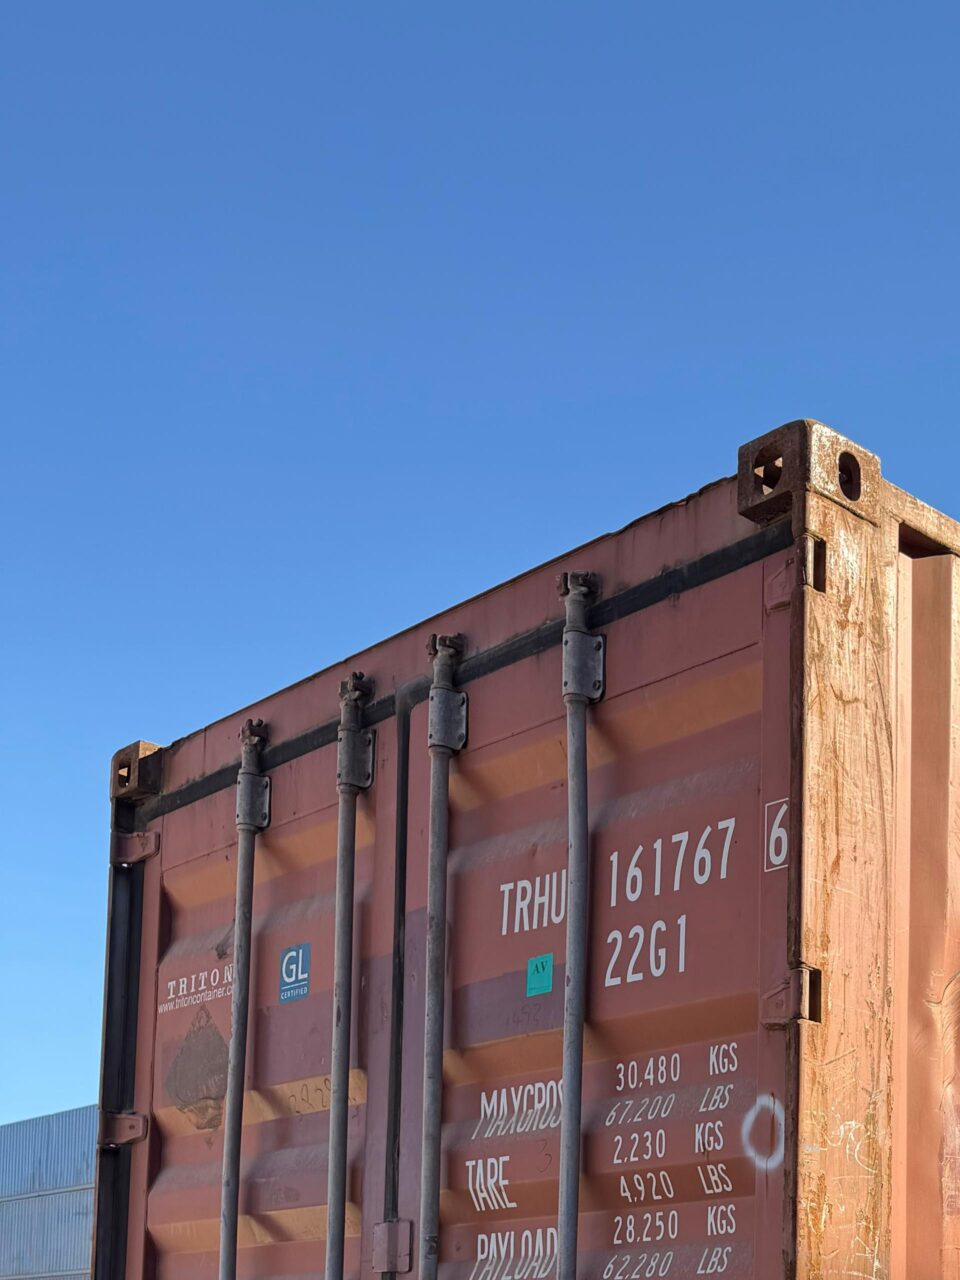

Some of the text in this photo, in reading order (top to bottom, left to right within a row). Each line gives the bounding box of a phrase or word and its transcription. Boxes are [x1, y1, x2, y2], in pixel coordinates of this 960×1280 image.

[500, 803, 789, 936] TRHU 161767 6
[281, 948, 309, 984] GL
[532, 959, 549, 975] AV
[605, 913, 687, 988] 22G1
[158, 984, 234, 1014] www.tritoncontainer.c
[167, 963, 234, 1000] TRITON
[280, 986, 309, 1000] CERTIFIED
[616, 1053, 681, 1092] 30,480
[709, 1041, 739, 1076] KGS
[605, 1083, 734, 1127] 67,200 LBS
[465, 1155, 518, 1212] TARE
[613, 1128, 667, 1165] 2,230
[694, 1120, 724, 1154] KGS
[619, 1163, 733, 1203] 4,920 LBS
[613, 1210, 679, 1246] 28,250
[706, 1203, 736, 1237] KGS
[602, 1246, 732, 1280] 62,280 LBS
